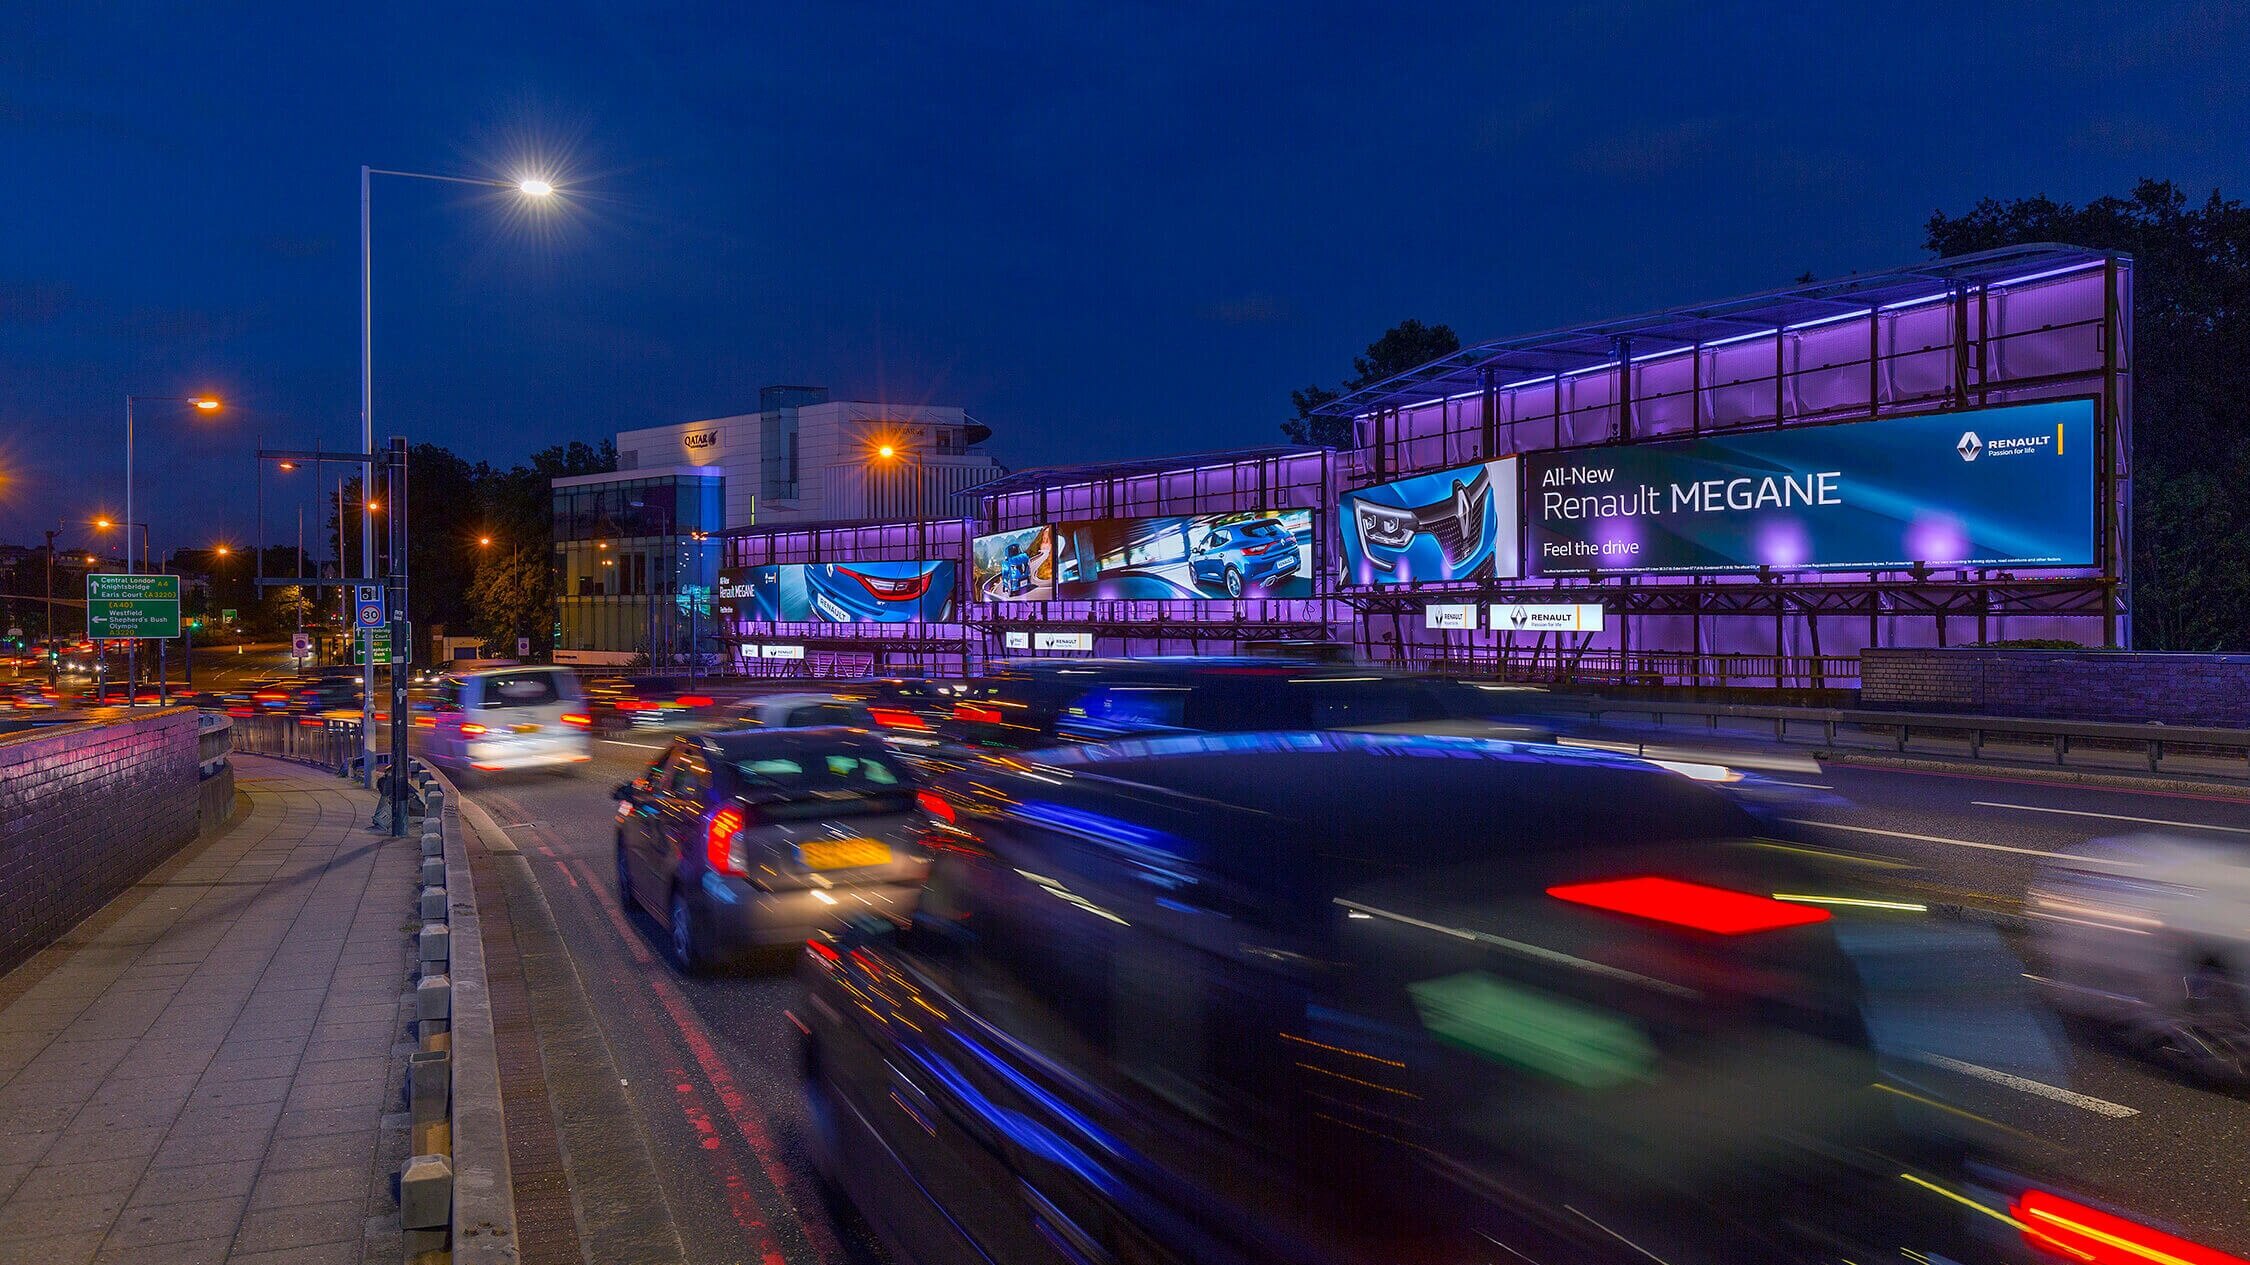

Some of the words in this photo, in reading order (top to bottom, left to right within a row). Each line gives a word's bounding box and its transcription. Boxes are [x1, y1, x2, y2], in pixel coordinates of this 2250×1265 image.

[684, 434, 708, 446] QATAR
[1988, 436, 2051, 449] RENAULT
[1988, 449, 2013, 457] Passion
[1542, 466, 1615, 487] All-New
[1543, 485, 1661, 521] Renault
[1670, 471, 1842, 513] MEGANE
[1543, 542, 1572, 557] Feel
[1574, 540, 1599, 556] the
[1602, 538, 1640, 555] drive
[363, 611, 378, 619] 30
[819, 598, 847, 621] RENAULT
